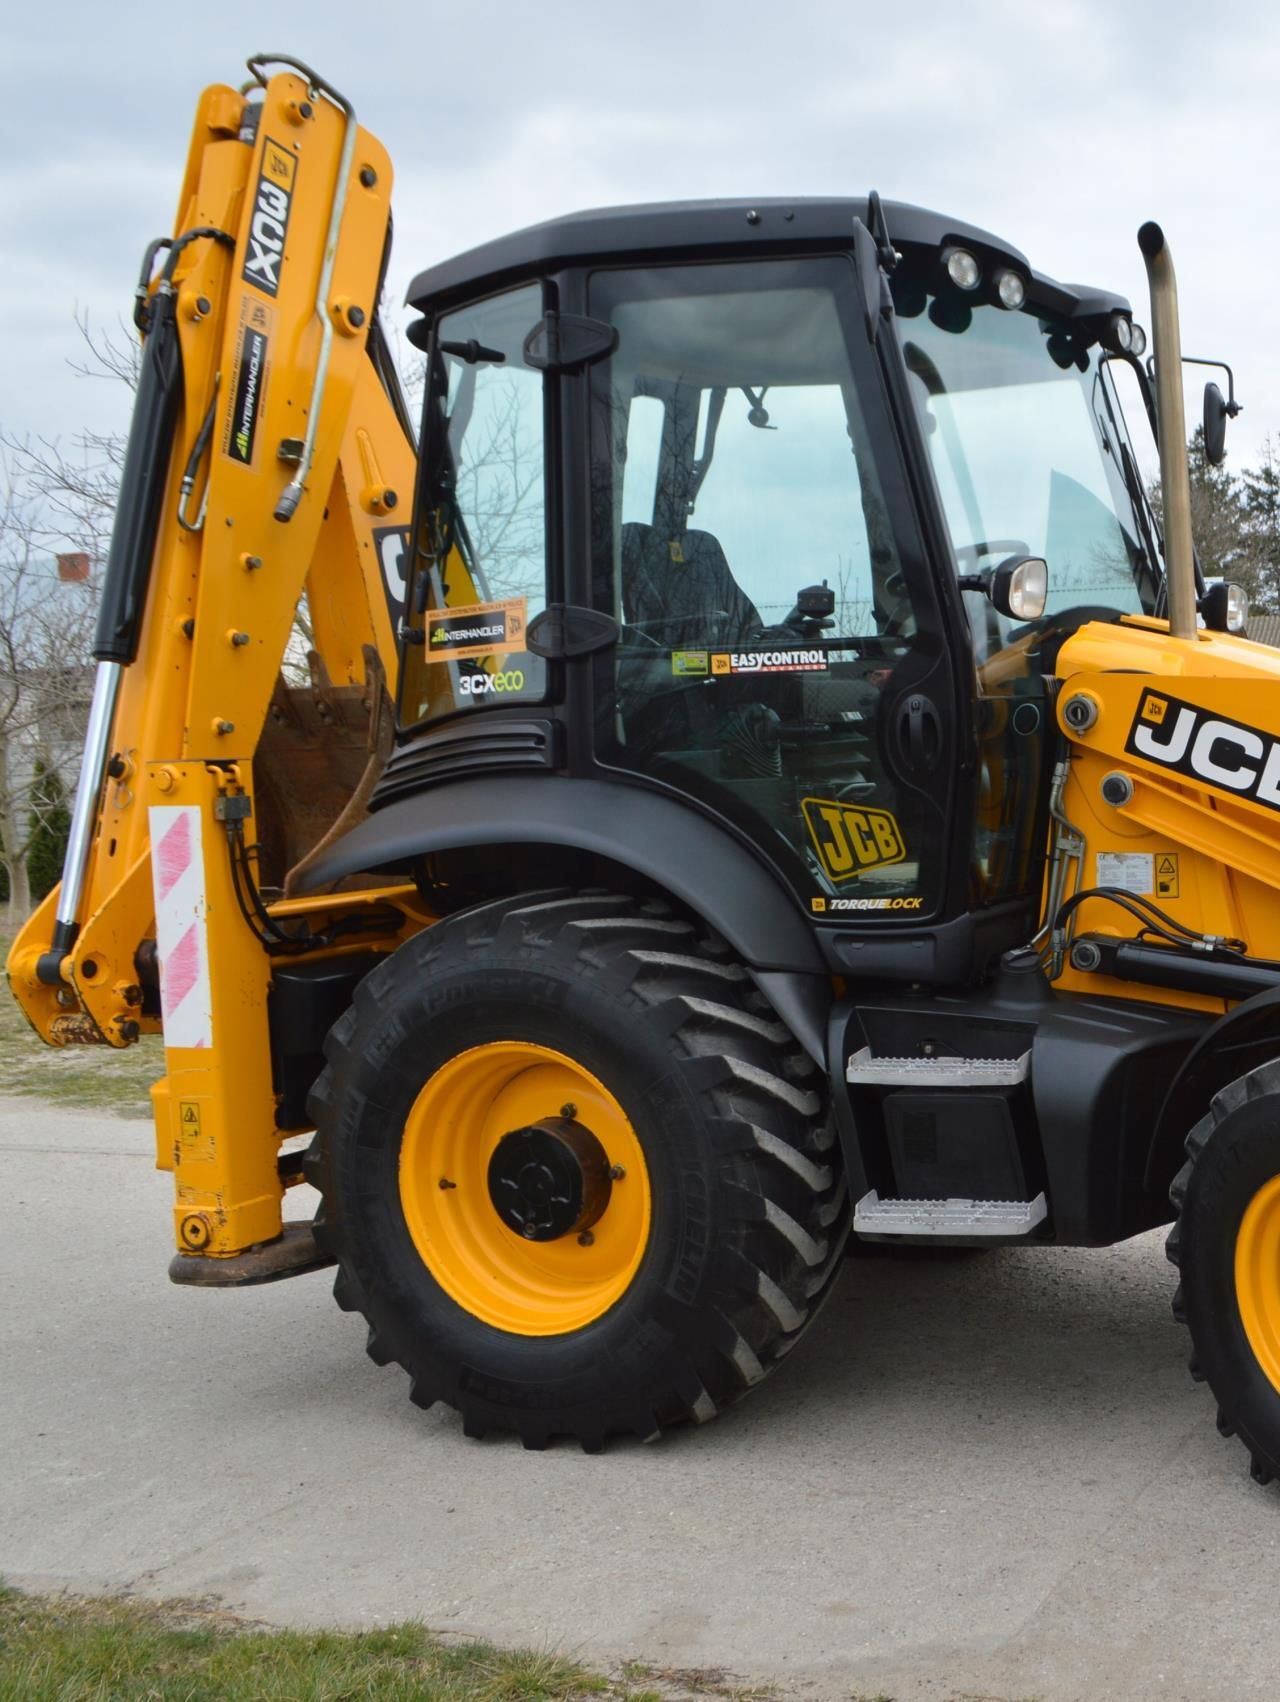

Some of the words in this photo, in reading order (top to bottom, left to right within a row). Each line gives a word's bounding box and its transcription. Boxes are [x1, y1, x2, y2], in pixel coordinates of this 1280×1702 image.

[245, 180, 289, 285] 3CX
[241, 335, 263, 437] INTERHANDLER
[444, 624, 504, 641] INTERHANDLER
[819, 806, 898, 872] JCB
[830, 897, 924, 911] TORQUELOCK
